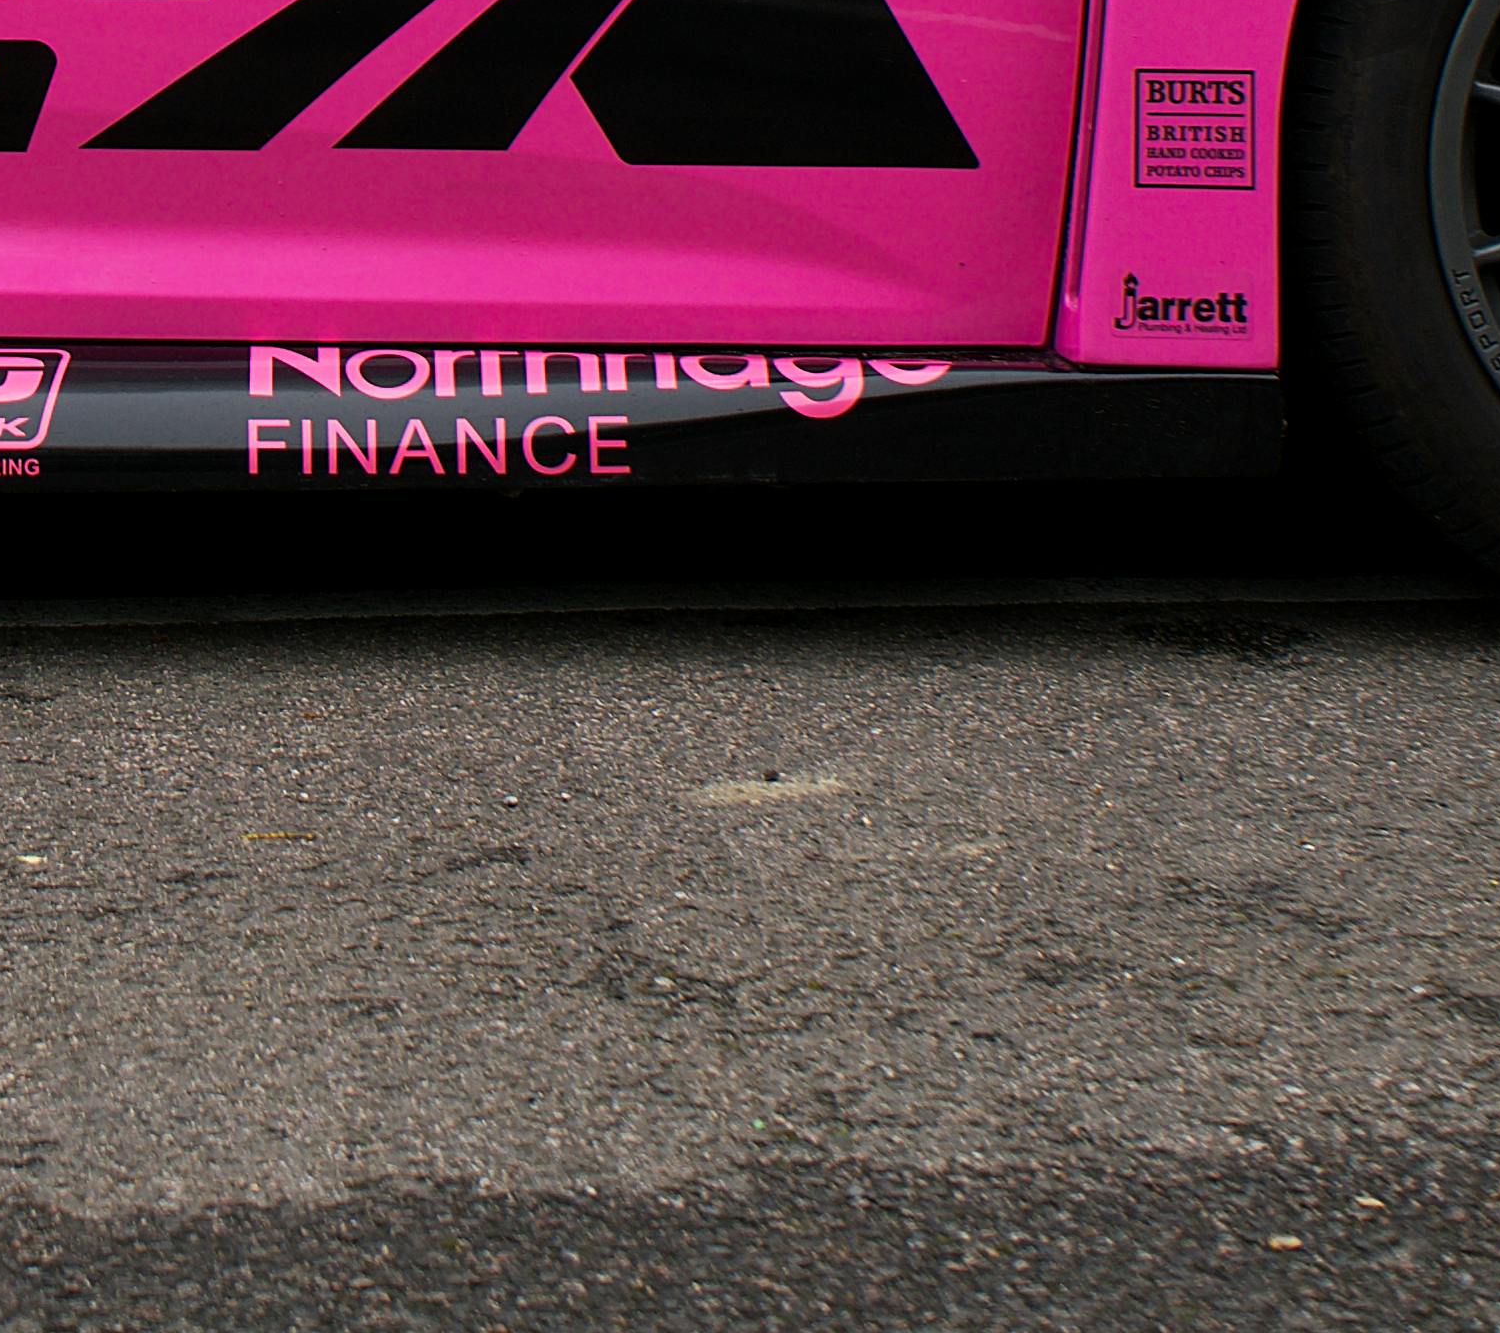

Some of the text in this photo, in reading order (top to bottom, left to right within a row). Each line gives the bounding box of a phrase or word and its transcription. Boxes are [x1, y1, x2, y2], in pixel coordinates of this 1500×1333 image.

[1145, 80, 1246, 106] BURTS
[1146, 125, 1246, 144] BRITISH
[1146, 147, 1246, 161] HAND COOKED
[1146, 165, 1246, 179] POTATO CHIPS
[1113, 271, 1248, 331] jarrett
[248, 414, 632, 476] FINANCE
